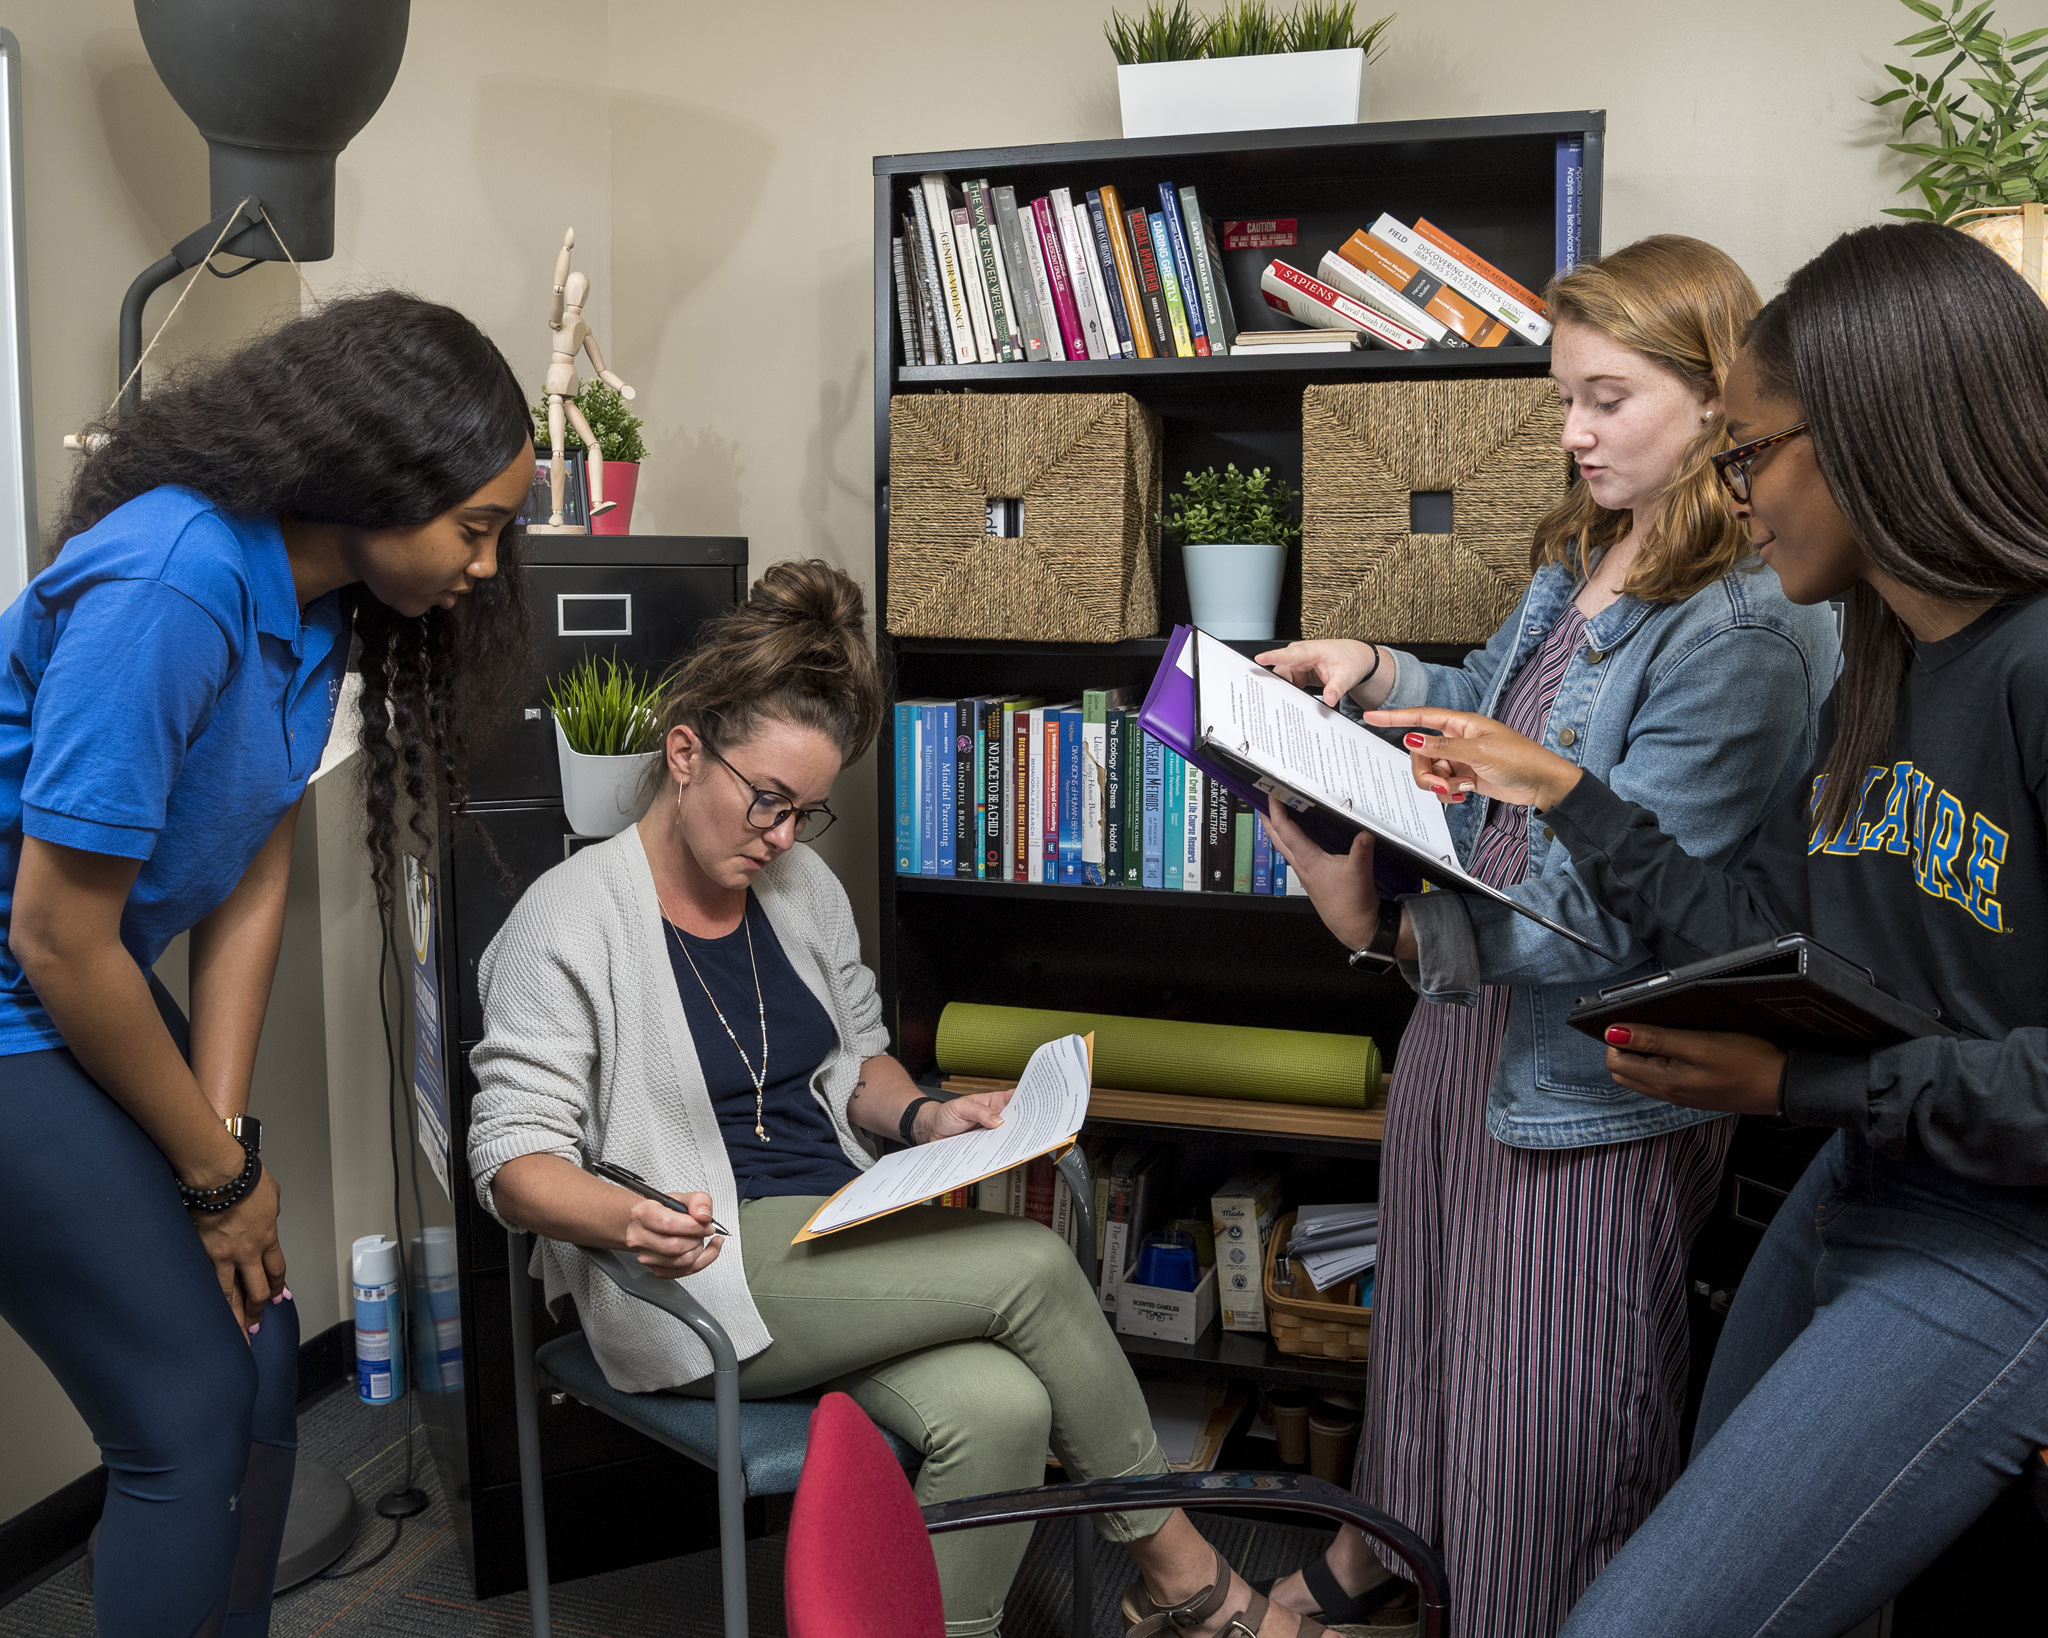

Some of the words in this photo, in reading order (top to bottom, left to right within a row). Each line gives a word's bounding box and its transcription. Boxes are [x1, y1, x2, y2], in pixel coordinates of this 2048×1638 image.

[970, 183, 982, 205] THE
[1566, 167, 1574, 195] Analysis
[974, 206, 986, 228] WAY
[1131, 211, 1150, 247] MEDICAL
[1247, 221, 1276, 233] CAUTION
[958, 226, 968, 239] Why
[979, 229, 990, 246] WE
[1387, 227, 1409, 244] FIELD
[1567, 214, 1575, 252] Behavioral
[961, 238, 971, 258] Gender
[1152, 220, 1169, 259] DARING
[1161, 259, 1178, 303] GREATLY
[1353, 237, 1375, 254] Structural
[1373, 251, 1392, 267] Equation
[1391, 263, 1412, 280] Modeling
[966, 258, 975, 279] Matters
[982, 248, 997, 284] NEVER
[1012, 241, 1024, 265] VOICES
[1023, 289, 1035, 315] VISIONS
[1034, 265, 1043, 277] On
[1054, 265, 1062, 281] DRUG
[1139, 247, 1160, 292] APARTHEID
[1190, 221, 1202, 252] LATENT
[1196, 251, 1210, 292] VARIABLE
[1204, 292, 1216, 325] MODELS
[1381, 262, 1395, 273] second
[1394, 271, 1408, 283] course
[1413, 249, 1428, 262] IBM
[1427, 258, 1446, 274] SPSS
[1444, 270, 1483, 299] STATISTICS
[940, 234, 955, 277] GENDER
[948, 278, 965, 332] VIOLENCE
[1057, 281, 1065, 292] USE
[1282, 269, 1335, 302] SAPIENS
[1411, 277, 1427, 297] Hancock
[1416, 243, 1465, 279] DISCOVERING
[1463, 274, 1503, 304] STATISTICS
[1501, 299, 1526, 319] USING
[1465, 254, 1476, 264] THE
[1476, 262, 1490, 273] BODY
[1491, 272, 1507, 285] KEEPS
[1508, 283, 1520, 293] THE
[1519, 291, 1538, 306] SCORE
[989, 283, 1004, 316] WERE
[1434, 296, 1451, 310] second
[1449, 307, 1465, 320] edition
[995, 319, 1005, 342] COONTZ
[1000, 316, 1010, 344] STEPHANIE
[1151, 297, 1160, 313] HARRIET
[1156, 318, 1166, 342] WASHINGTON
[1340, 301, 1360, 317] Yuval
[1359, 312, 1379, 327] Noah
[1378, 322, 1403, 340] Harari
[1110, 719, 1119, 735] The
[988, 742, 1000, 756] NO
[1017, 737, 1026, 766] BECOMING
[1050, 733, 1058, 760] Intentional
[1108, 738, 1118, 769] Ecology
[1145, 741, 1161, 775] RESEARCH
[925, 745, 933, 791] Mindfulness
[941, 762, 951, 801] Mindful
[988, 756, 1000, 780] PLACE
[1050, 761, 1058, 790] Interviewing
[1110, 772, 1118, 781] of
[1188, 767, 1199, 778] The
[957, 761, 965, 806] MINDFUL
[988, 780, 1000, 793] TO
[1017, 772, 1026, 803] BEHAVIORAL
[1050, 790, 1058, 800] and
[1087, 779, 1096, 802] Human
[1109, 783, 1117, 808] Stress
[1145, 778, 1161, 812] METHODS
[1188, 779, 1199, 794] Craft
[925, 792, 933, 803] for
[988, 794, 1000, 803] BE
[988, 804, 1000, 812] A
[1188, 802, 1199, 813] Life
[925, 804, 933, 839] Teachers
[940, 803, 950, 847] Parenting
[957, 809, 965, 839] BRAIN
[988, 811, 1000, 837] CHILD
[1017, 803, 1026, 825] SCIENCE
[1050, 800, 1058, 832] Counseling
[1087, 802, 1096, 829] Behavior
[1188, 814, 1199, 835] Course
[1210, 808, 1218, 846] METHODS
[1219, 804, 1228, 834] APPLIED
[1017, 826, 1026, 860] RESEARCHER
[1109, 824, 1117, 852] Hobfoll
[1188, 836, 1199, 864] Research
[1058, 1198, 1068, 1221] HIGHLY
[1111, 1224, 1121, 1240] The
[1110, 1241, 1120, 1263] Great
[1108, 1264, 1118, 1284] Ideas
[1133, 1300, 1155, 1309] SCENTED
[1157, 1303, 1179, 1312] CANDLES
